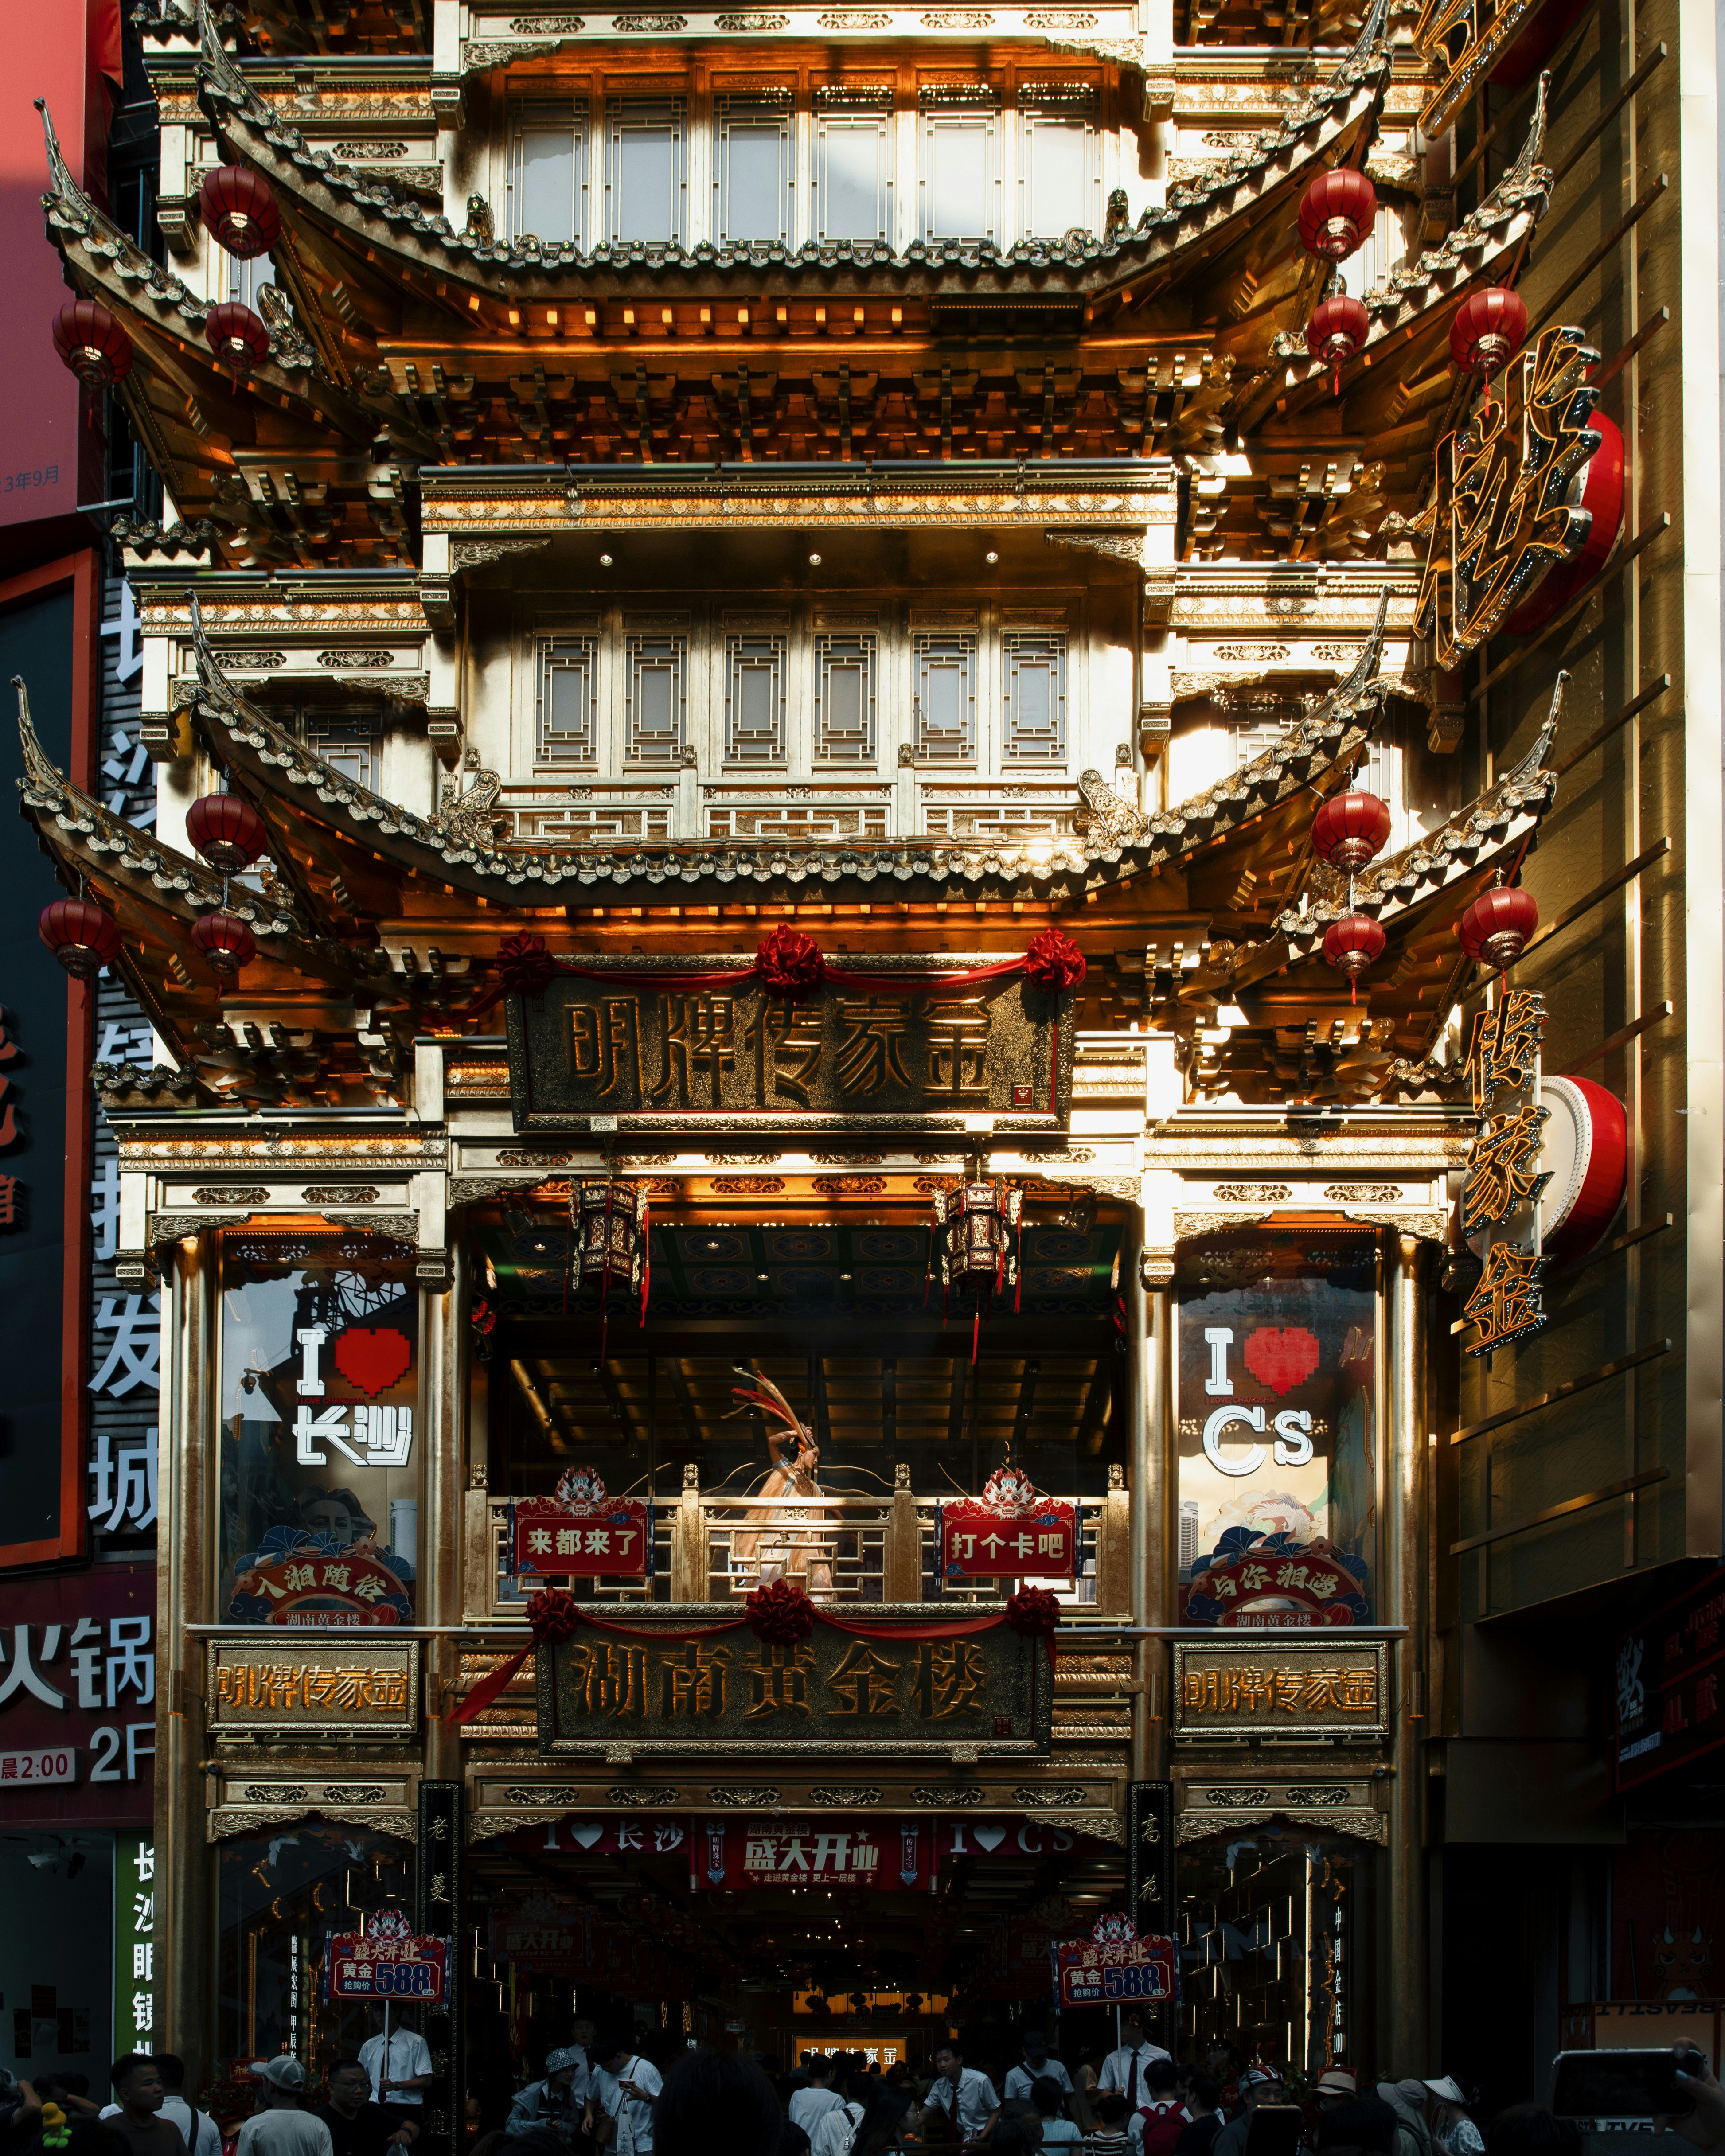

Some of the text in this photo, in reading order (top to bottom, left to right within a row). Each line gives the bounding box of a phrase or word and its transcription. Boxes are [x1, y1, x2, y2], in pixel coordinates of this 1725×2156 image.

[0, 465, 59, 493] 3年9月
[564, 990, 992, 1107] 明牌传家金
[296, 1328, 325, 1396] I
[1204, 1327, 1234, 1396] I
[292, 1405, 413, 1466] 长沙
[1202, 1405, 1314, 1477] CS
[527, 1528, 638, 1556] 来都来了
[950, 1532, 1065, 1559] 打个卡吧
[286, 1614, 360, 1626] 湖南黄金楼
[1237, 1614, 1311, 1627] 湖南黄金楼
[0, 1615, 154, 1709] 火锅
[1014, 1634, 1027, 1717] 辰年孟夏
[216, 1663, 407, 1709] 明牌传家金
[570, 1639, 987, 1720] 湖南黄金楼
[1185, 1666, 1378, 1711] 明牌传家金
[90, 1722, 156, 1782] 2F
[543, 1821, 560, 1850] I
[614, 1820, 685, 1852] 长沙
[749, 1822, 808, 1835] 湖南黄金楼
[949, 1823, 968, 1853] I
[743, 1834, 879, 1871] 盛大开业
[763, 1873, 856, 1883] 走进黄金楼 更上一层楼
[353, 1942, 421, 1962] 盛大开业
[1081, 1942, 1151, 1968] 盛大开业
[342, 1963, 373, 1979] 黄金
[344, 1981, 370, 1990] 抢购价
[375, 1962, 431, 1996] 588
[1070, 1969, 1101, 1987] 黄金
[1104, 1964, 1160, 1999] 588
[1073, 1987, 1100, 1998] 抢购价
